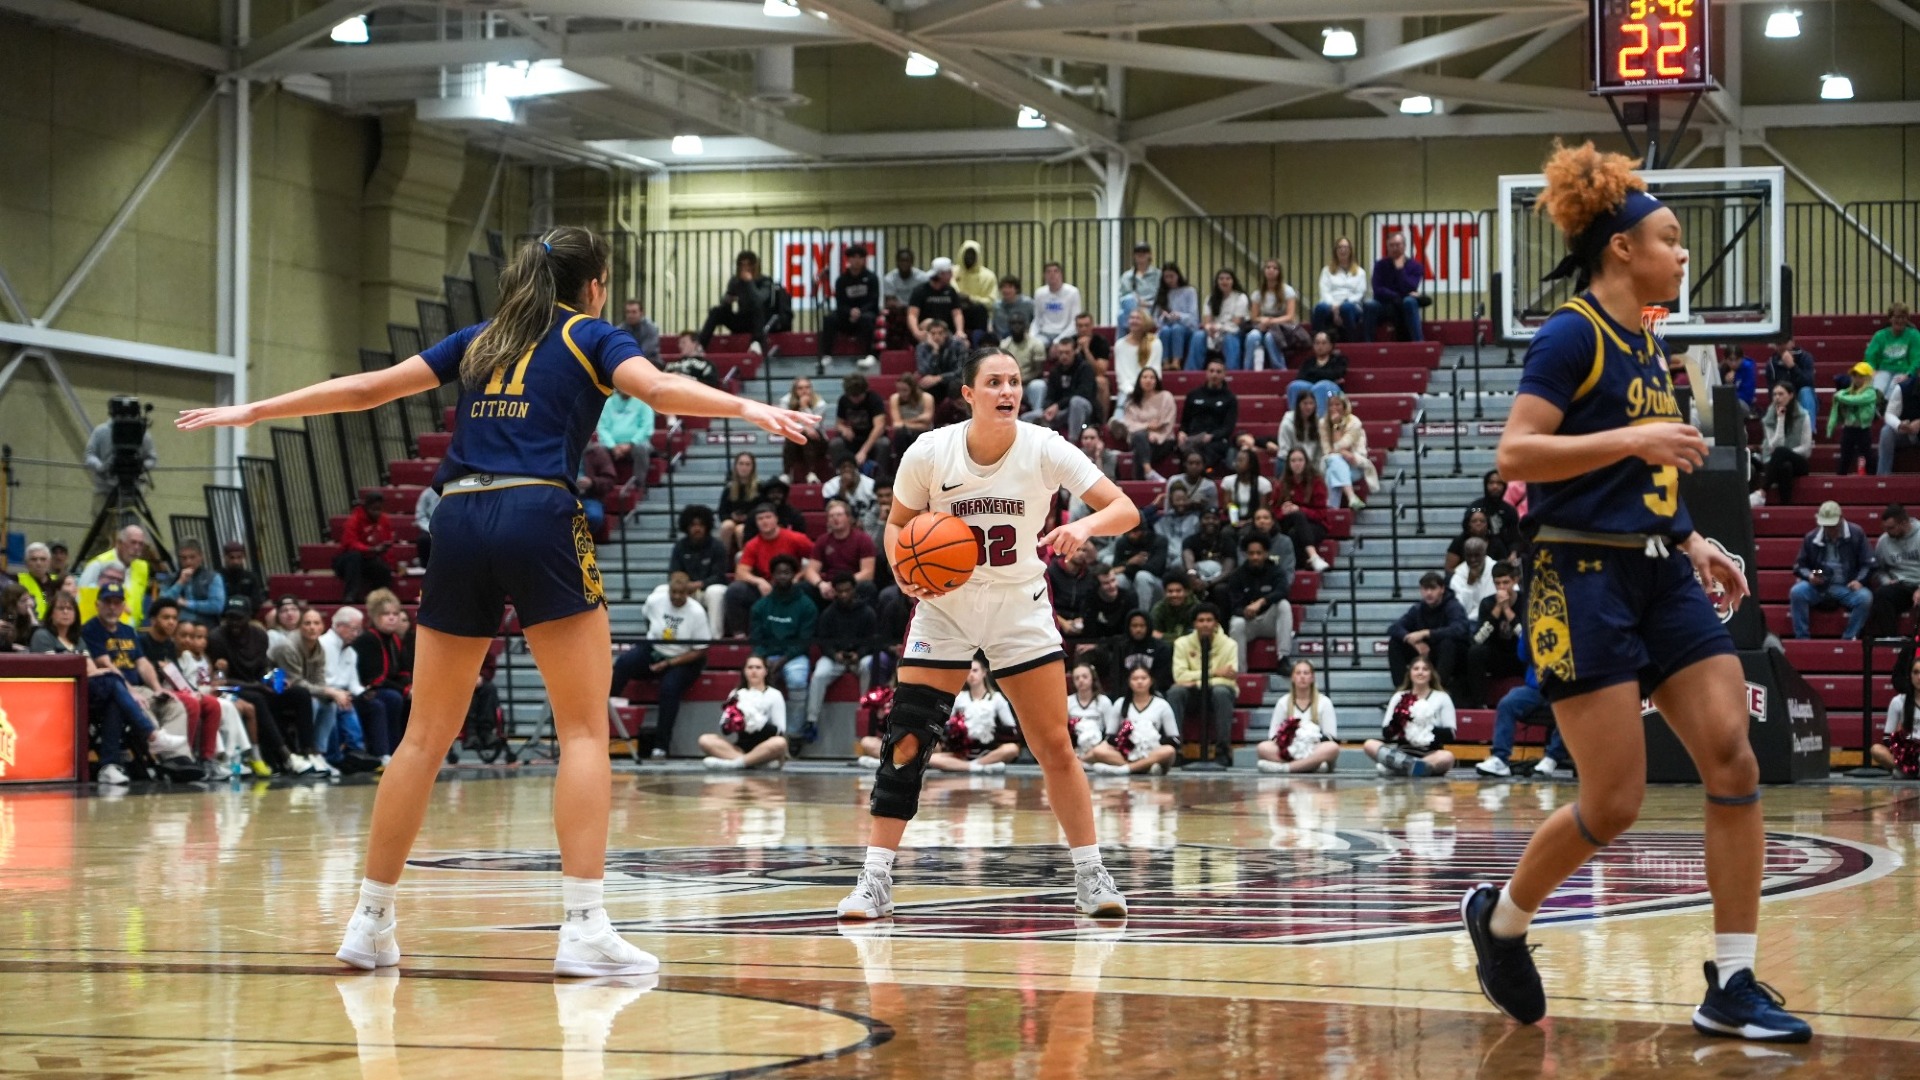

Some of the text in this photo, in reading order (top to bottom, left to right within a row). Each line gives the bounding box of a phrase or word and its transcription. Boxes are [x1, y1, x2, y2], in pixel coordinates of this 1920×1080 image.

[1618, 21, 1687, 77] 22
[1624, 78, 1679, 86] DAKTRONICS
[484, 342, 538, 396] 11
[470, 400, 529, 419] CITRON
[951, 497, 1026, 517] LAFAYETTE
[1643, 464, 1679, 518] 3
